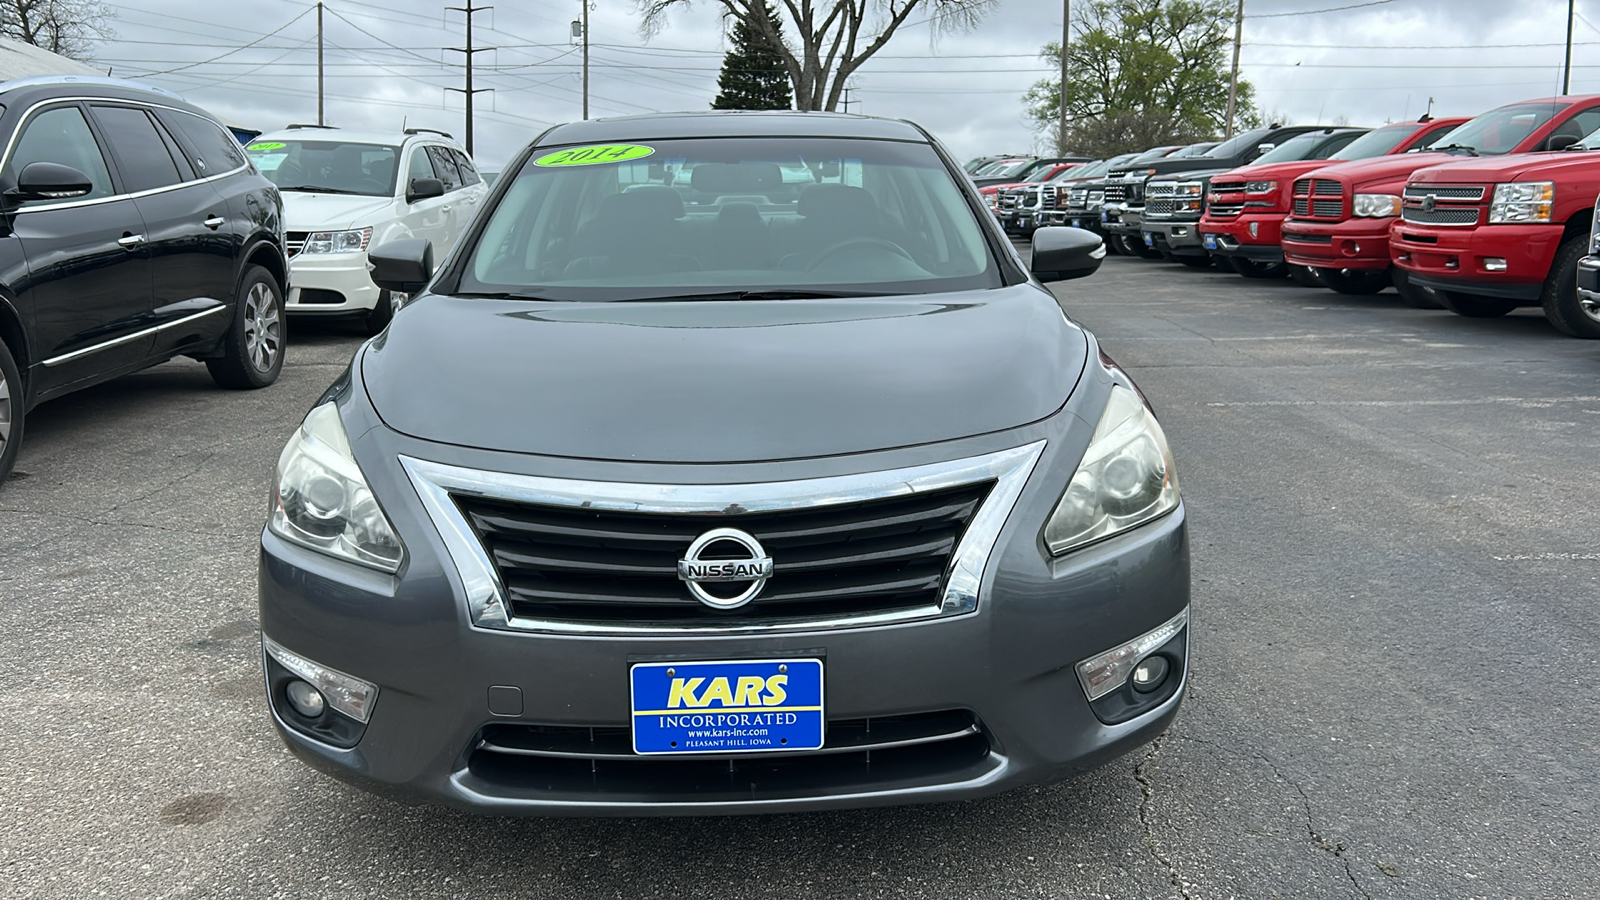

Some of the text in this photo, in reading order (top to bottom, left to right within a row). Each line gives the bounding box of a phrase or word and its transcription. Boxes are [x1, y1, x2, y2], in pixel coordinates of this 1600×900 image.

[547, 146, 635, 165] 2014
[688, 563, 763, 577] NISSAN
[667, 674, 788, 708] KARS
[659, 712, 797, 728] INCORPORATED
[688, 727, 768, 738] www.kars-inc.com
[749, 738, 772, 746] IOWA
